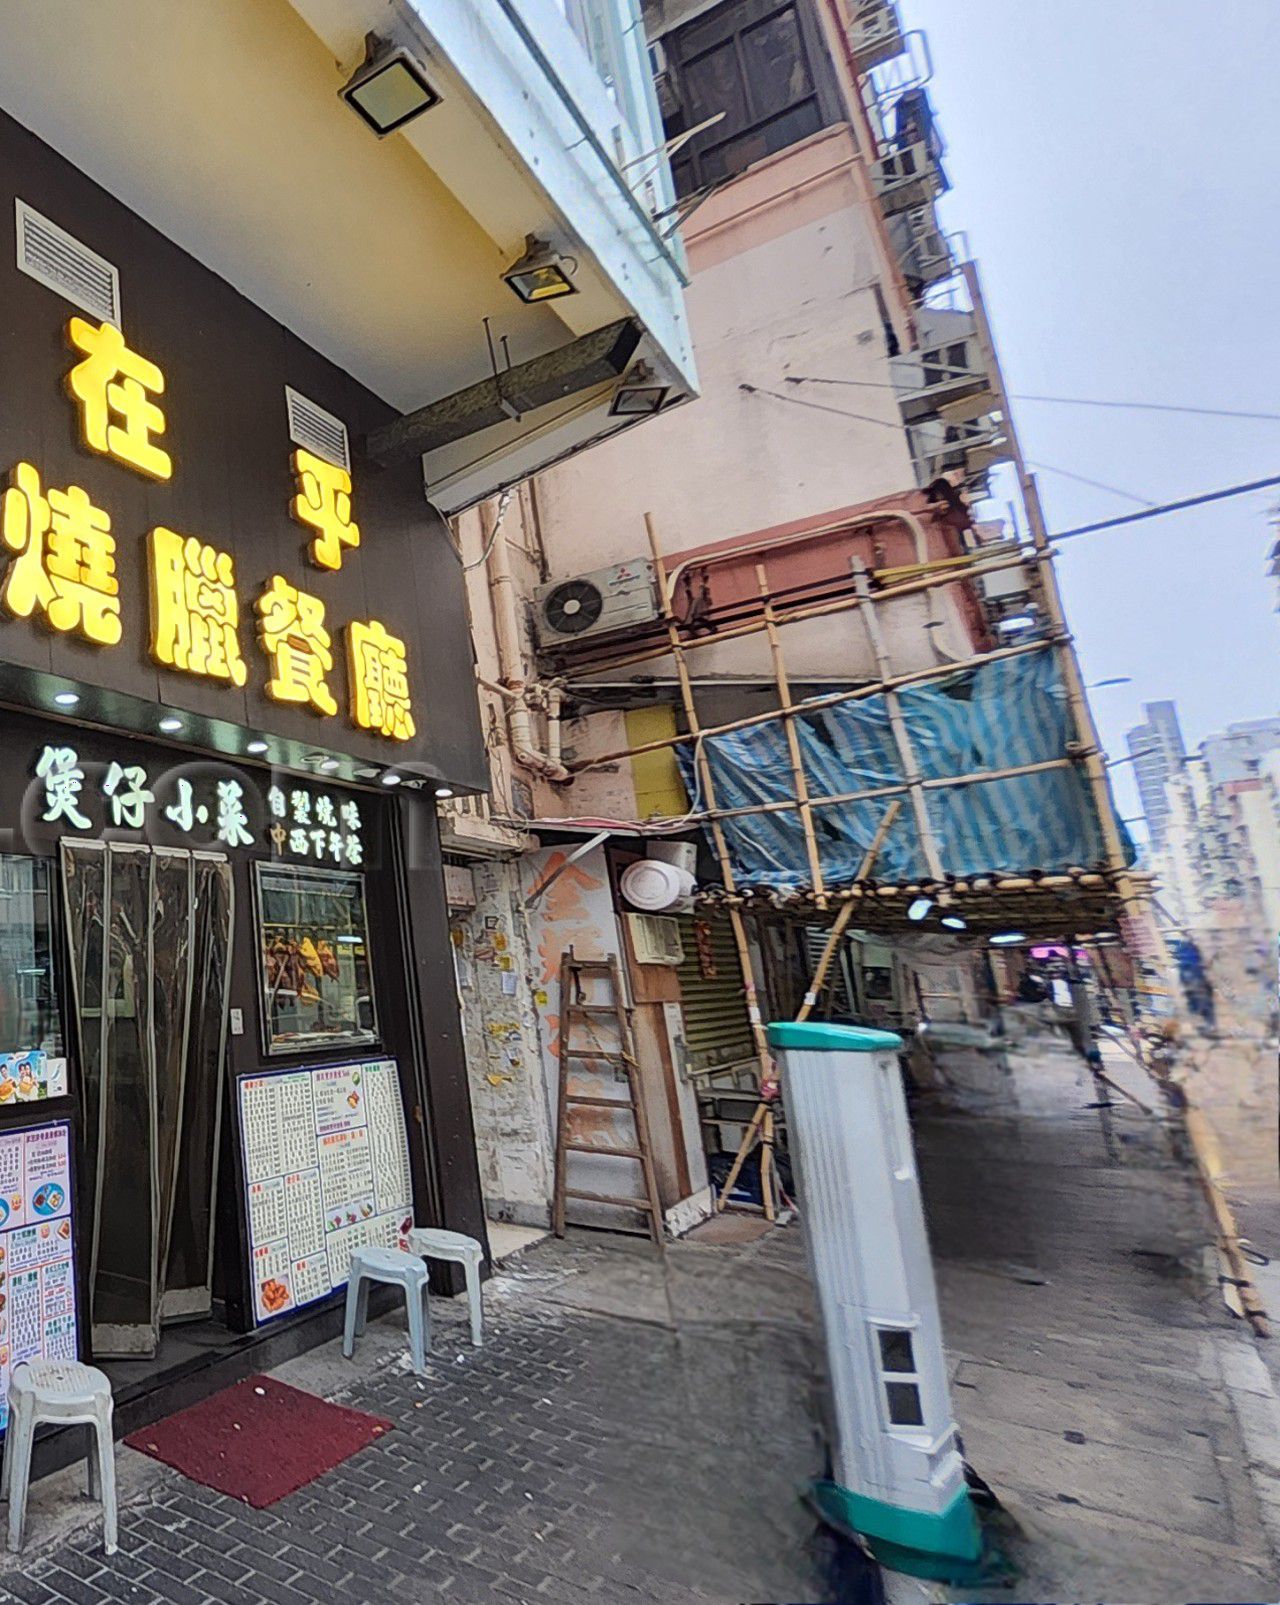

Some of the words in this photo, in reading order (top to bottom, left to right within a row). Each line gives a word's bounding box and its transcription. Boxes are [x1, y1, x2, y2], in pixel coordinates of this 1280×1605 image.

[1, 462, 417, 740] 燒臘餐廳
[35, 745, 255, 848] 煲仔小菜
